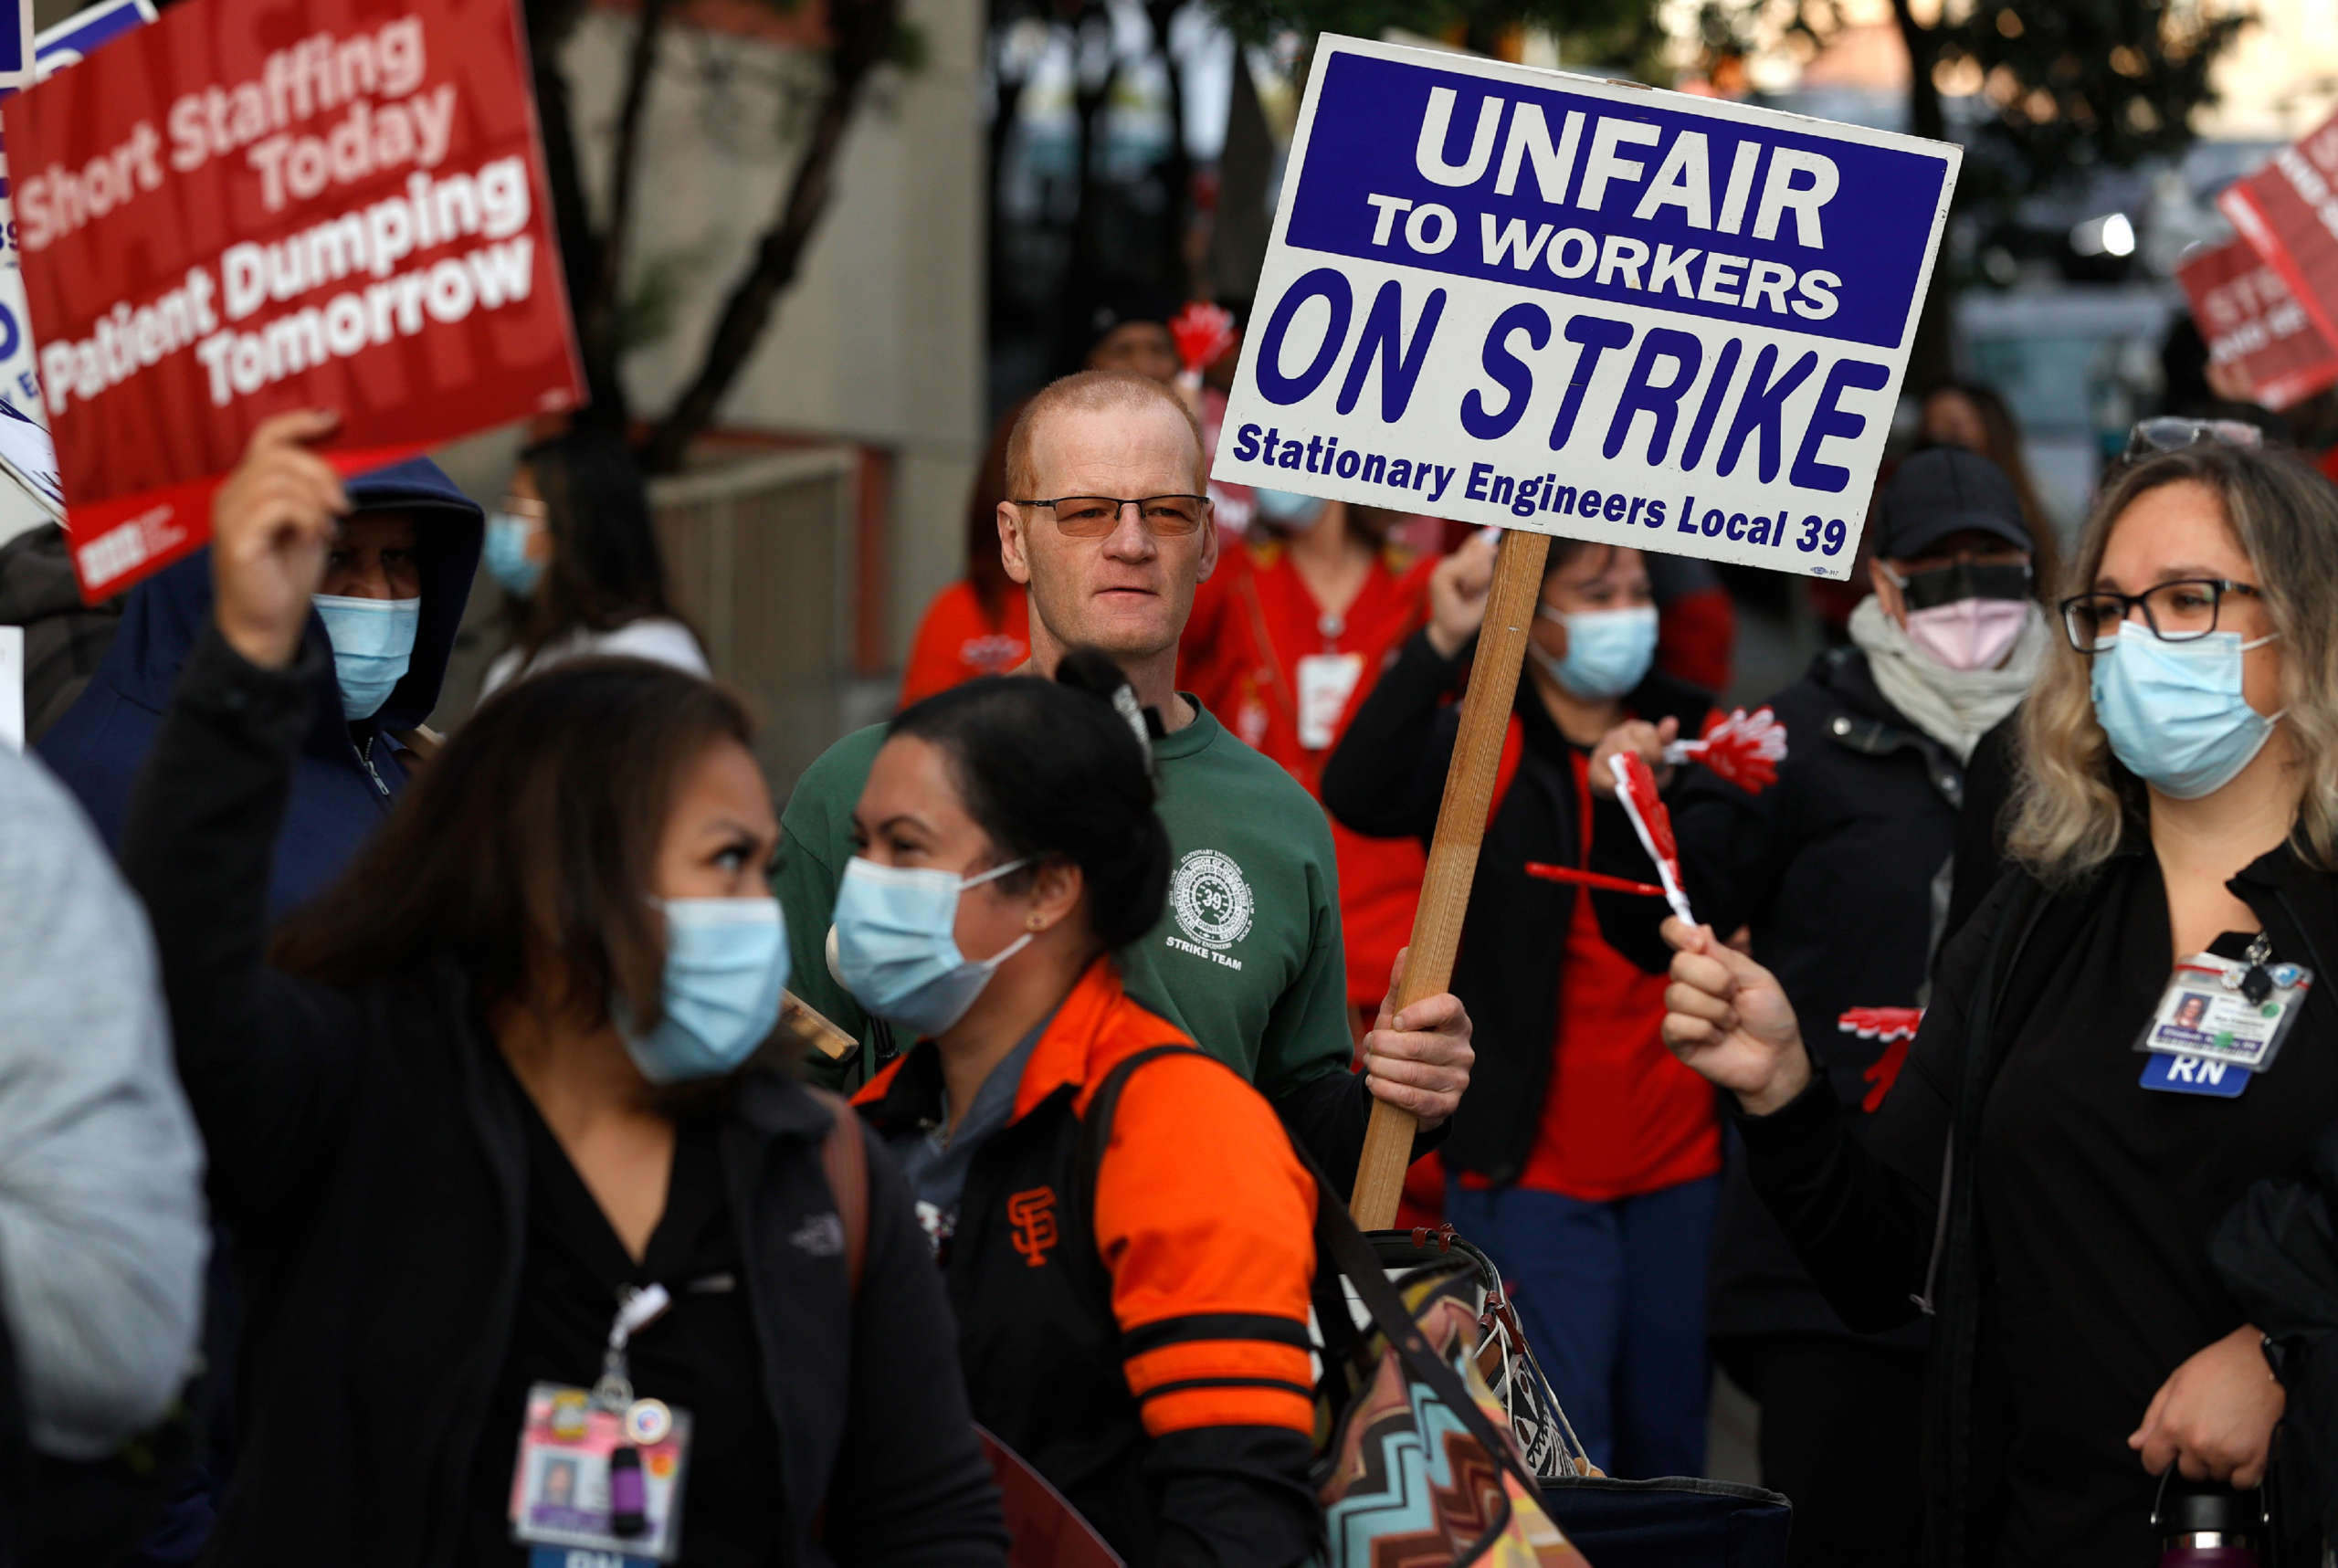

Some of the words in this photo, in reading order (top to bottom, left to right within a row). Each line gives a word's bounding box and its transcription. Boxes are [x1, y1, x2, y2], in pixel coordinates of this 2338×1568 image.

[17, 120, 163, 251] Short
[168, 13, 425, 172] Staffing
[246, 82, 456, 212] Today
[1416, 87, 1839, 248] UNFAIR
[41, 267, 218, 416] Patient
[221, 154, 532, 320] Dumping
[195, 234, 534, 407] Tomorrow
[1367, 194, 1457, 254] TO
[1481, 213, 1842, 320] WORKERS
[1256, 268, 1447, 423] ON
[1460, 302, 1890, 492] STRIKE
[1233, 424, 1456, 501] Stationary
[1465, 462, 1666, 528] Engineers
[1678, 496, 1788, 546] Local
[1796, 515, 1846, 555] 39
[1166, 937, 1209, 959] STRIKE
[1211, 951, 1242, 972] TEAM
[1176, 867, 1195, 931] INTERNATIONAL
[1188, 858, 1210, 871] UNION
[1213, 858, 1223, 868] OF
[1203, 889, 1222, 910] 39
[2166, 1055, 2228, 1086] RN
[1008, 1185, 1058, 1268] SF
